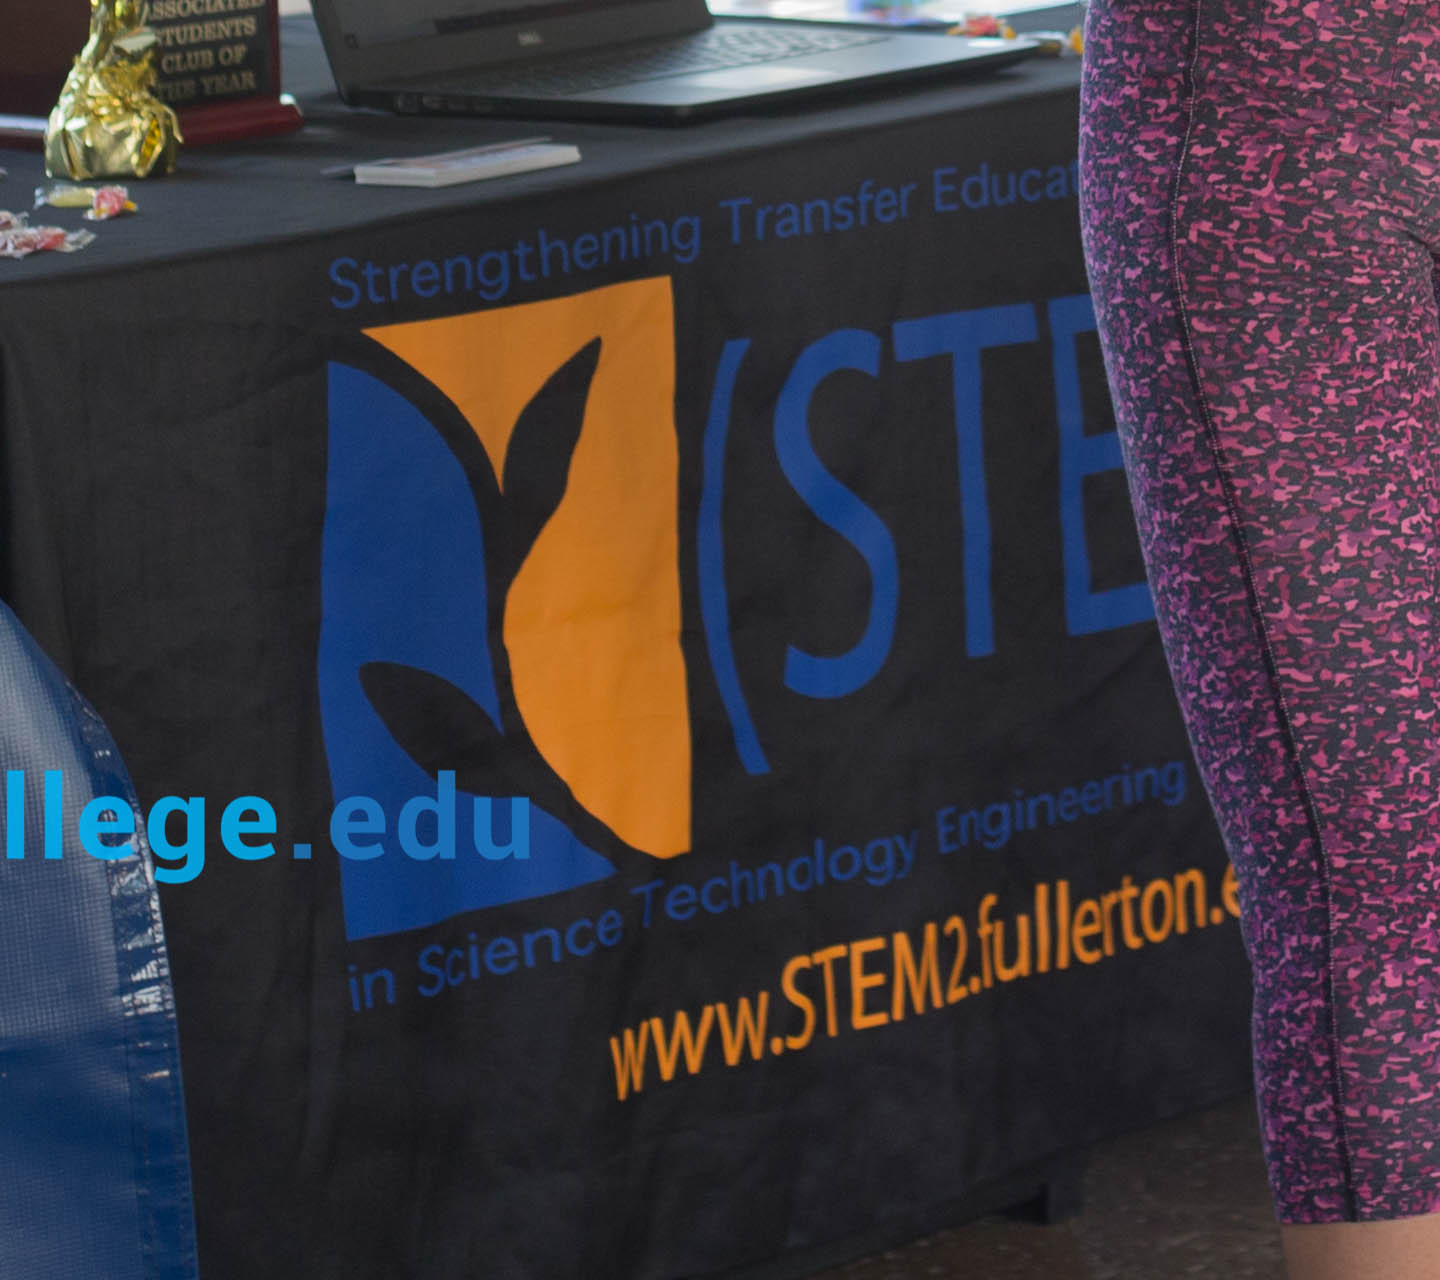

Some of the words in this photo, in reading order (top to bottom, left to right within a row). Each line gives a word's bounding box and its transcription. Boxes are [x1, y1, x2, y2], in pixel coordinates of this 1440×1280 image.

[162, 50, 213, 73] CLUB
[219, 46, 246, 65] OF
[202, 72, 255, 95] YEAR
[328, 210, 702, 311] Strengthening
[719, 178, 917, 247] Transfer
[346, 962, 396, 1013] in
[416, 910, 624, 1000] Science
[630, 828, 918, 930] Technology
[935, 758, 1189, 850] Engineering
